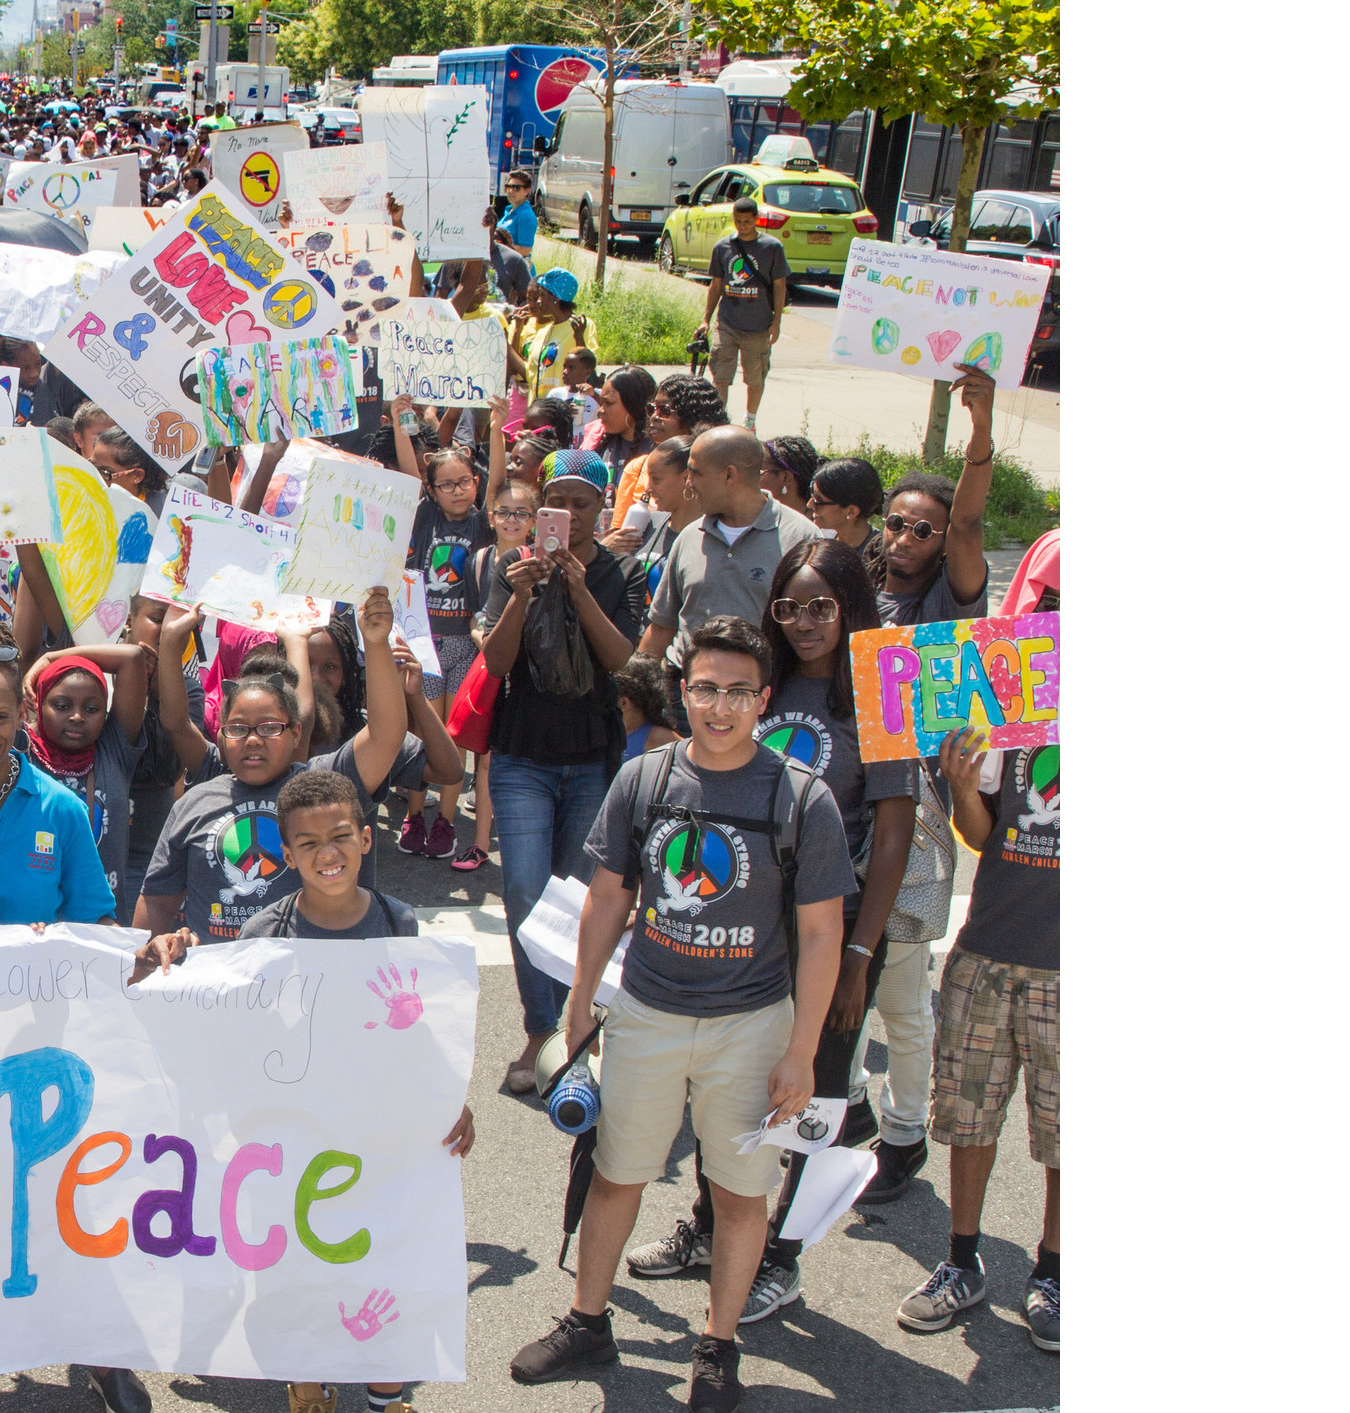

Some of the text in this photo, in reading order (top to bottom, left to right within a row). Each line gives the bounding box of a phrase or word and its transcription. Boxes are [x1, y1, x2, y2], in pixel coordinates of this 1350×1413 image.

[187, 195, 285, 291] PEACE
[154, 231, 249, 326] LOVE
[851, 264, 934, 297] PEACE
[935, 285, 983, 306] NOT
[130, 266, 215, 348] UNITY
[390, 321, 454, 355] Peace
[67, 311, 169, 420] RESPECT
[393, 363, 484, 401] March
[360, 385, 378, 398] 018
[224, 505, 233, 519] 2
[280, 528, 289, 543] 4
[878, 636, 1059, 737] PEACE
[784, 711, 833, 777] WE ARE STRONG
[235, 800, 256, 813] WE
[1001, 850, 1030, 865] HARLEM
[1016, 843, 1053, 856] MARCH
[1017, 832, 1055, 847] PEACE
[733, 835, 751, 889] STRONG
[644, 925, 755, 958] HARLEM CHILDREN'S ZONE
[657, 915, 756, 947] PEACE 2018
[658, 924, 692, 943] MARCH
